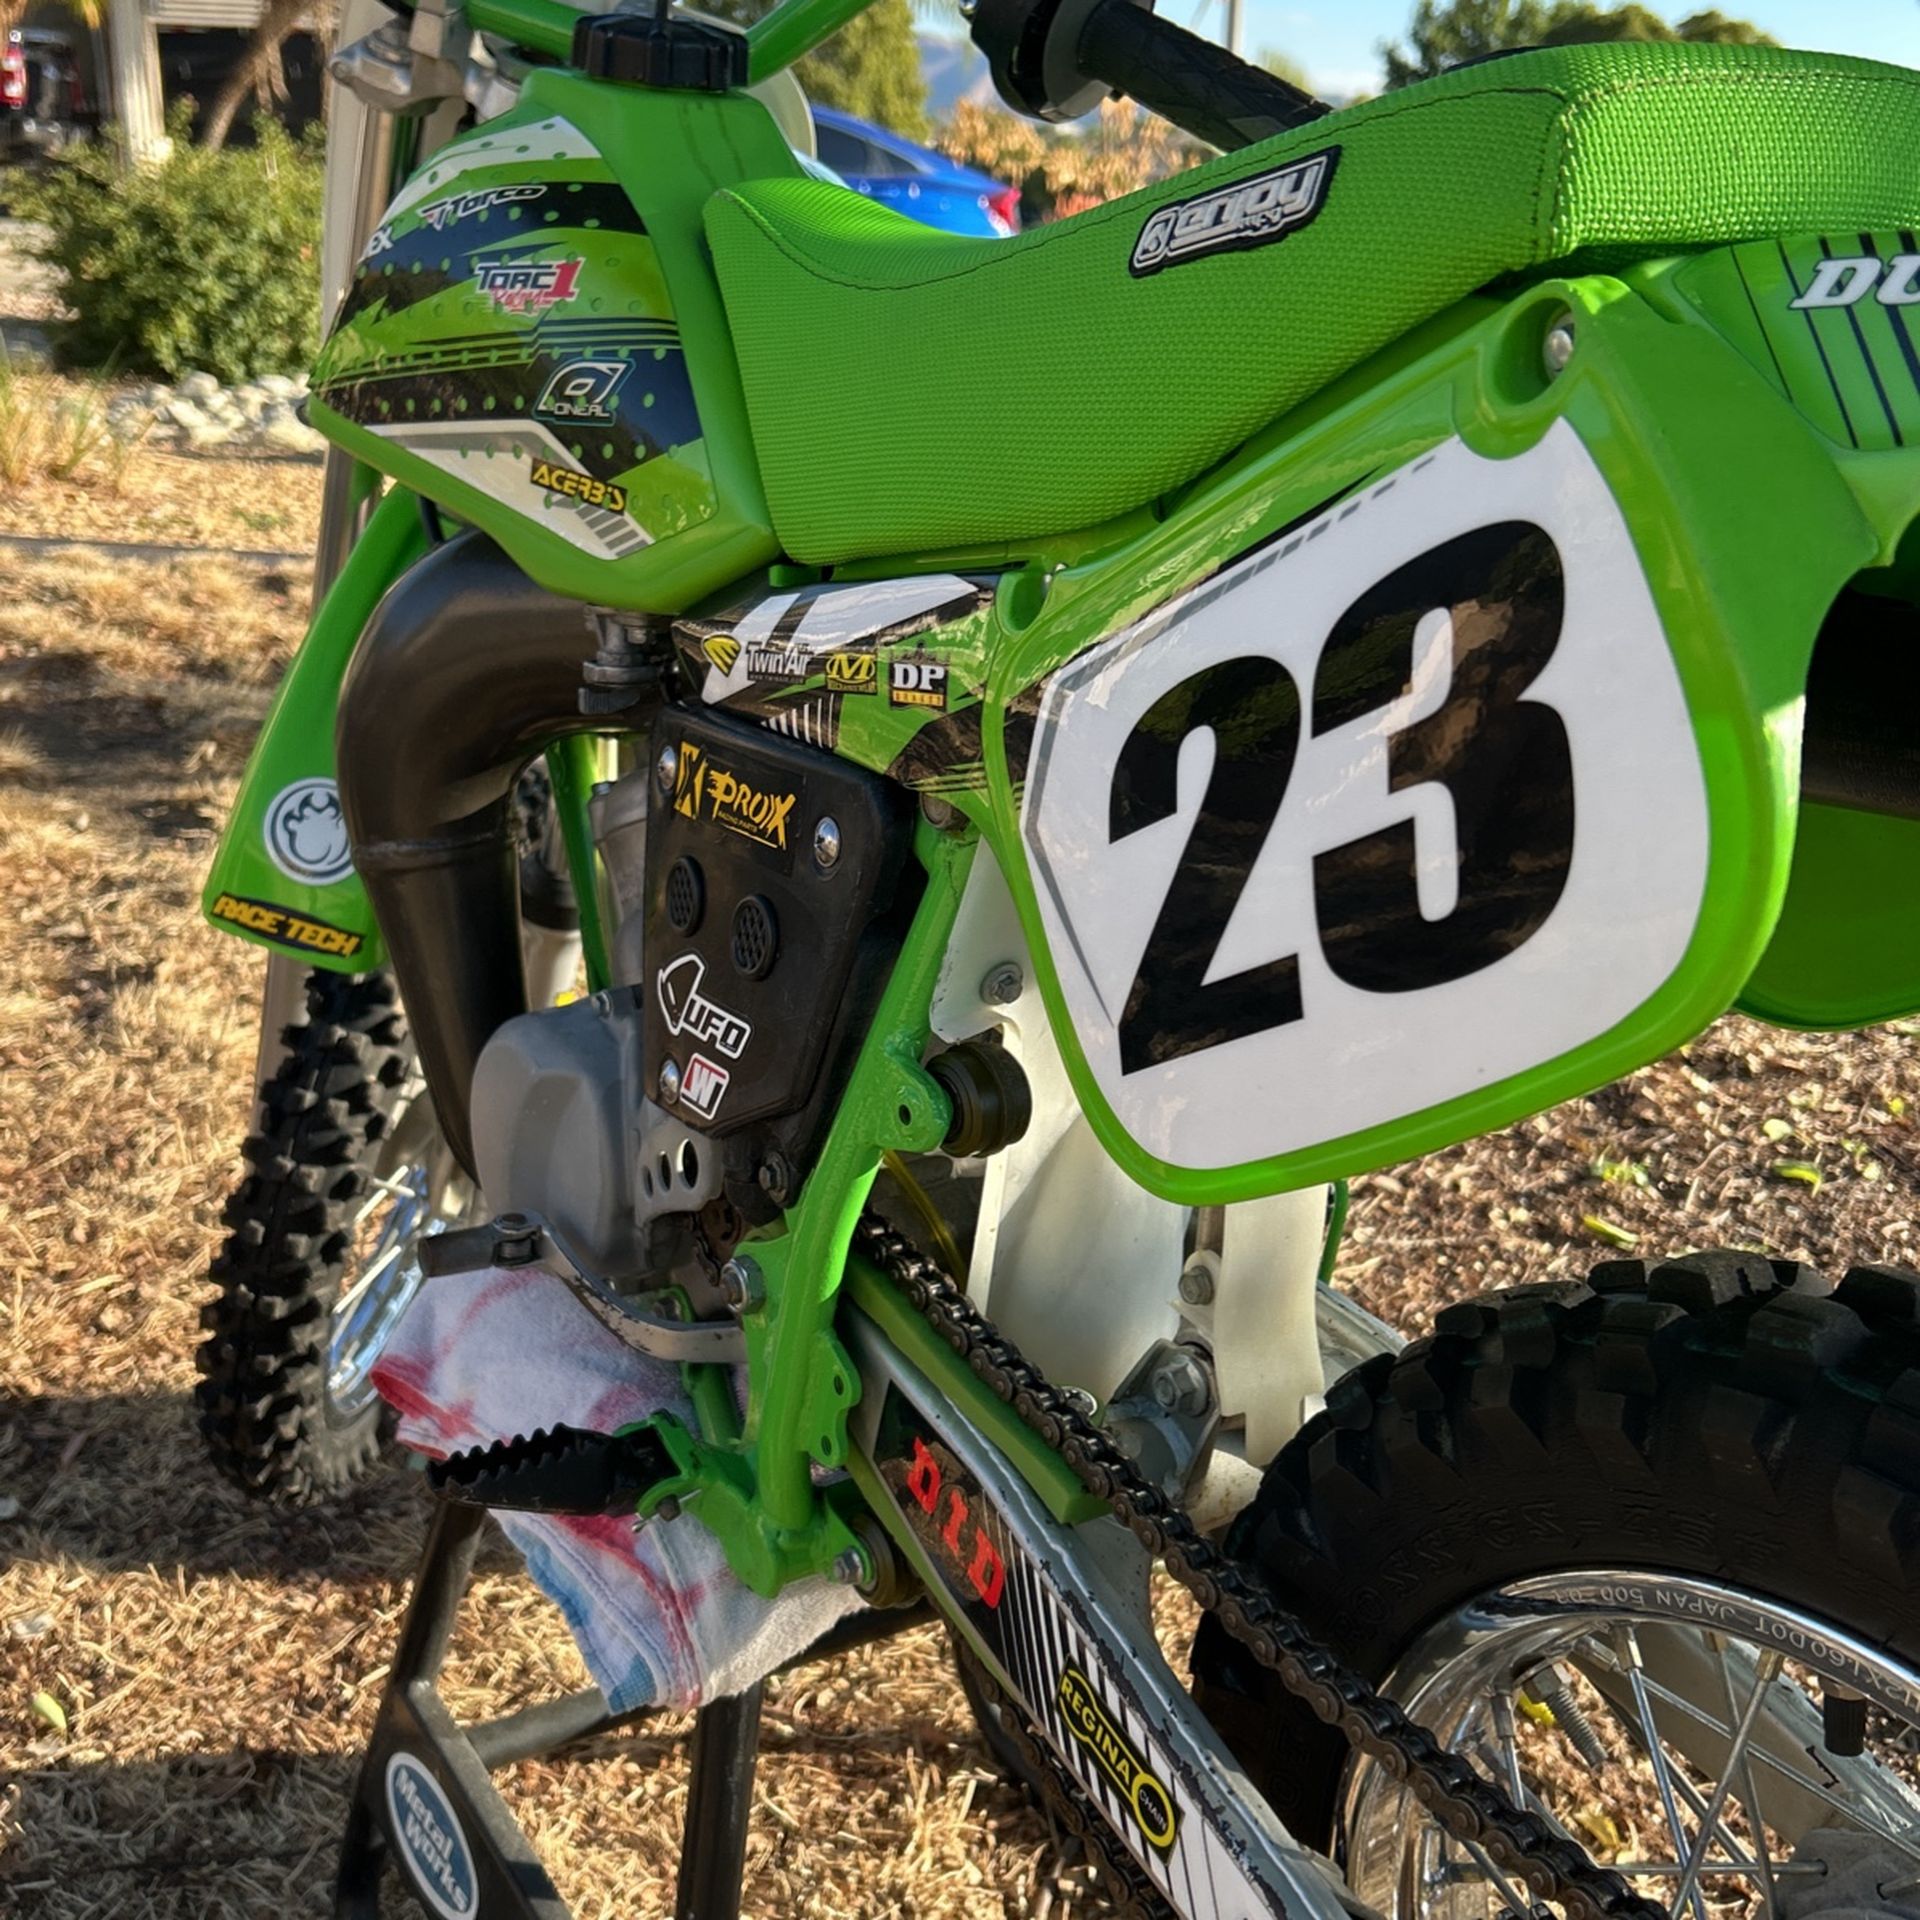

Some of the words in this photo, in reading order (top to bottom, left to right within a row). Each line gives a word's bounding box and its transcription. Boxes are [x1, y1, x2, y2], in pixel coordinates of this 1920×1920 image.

[532, 463, 625, 512] ACERBS
[893, 663, 945, 690] DP
[1108, 518, 1576, 1077] 23
[212, 894, 287, 935] RACE
[284, 916, 360, 959] TECH
[683, 997, 748, 1053] UFO
[1060, 1674, 1132, 1785] REGINA
[394, 1766, 455, 1861] Metal
[1138, 1788, 1168, 1832] CHAIN
[405, 1811, 470, 1914] Works
